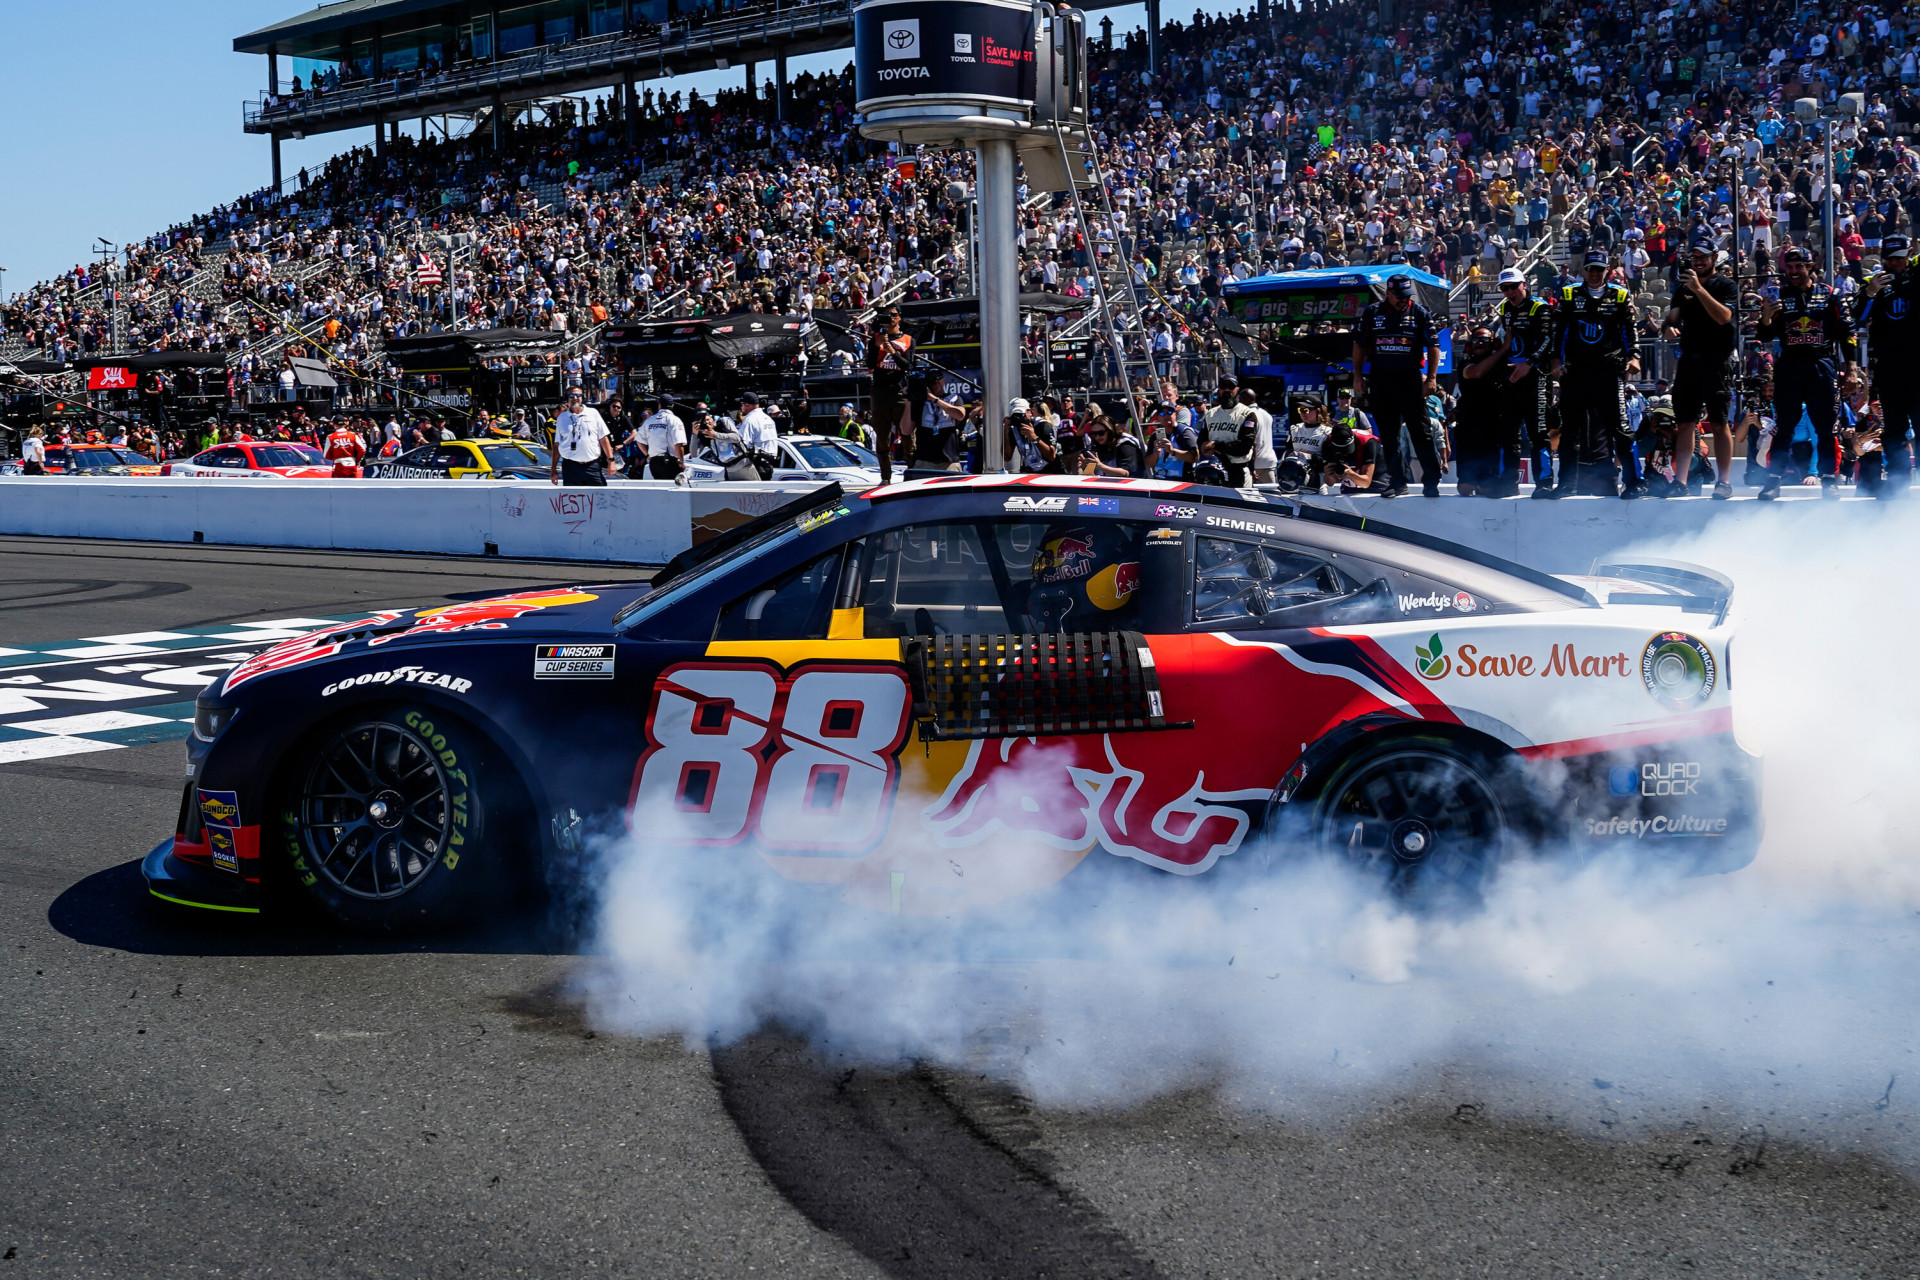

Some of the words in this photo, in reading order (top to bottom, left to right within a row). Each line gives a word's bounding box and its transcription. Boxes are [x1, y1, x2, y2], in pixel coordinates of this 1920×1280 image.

[951, 55, 976, 63] TOYOTA
[986, 46, 1008, 59] SAVE
[1009, 49, 1033, 62] MART
[986, 58, 1014, 67] COMPANIES
[877, 66, 930, 81] TOYOTA
[1787, 333, 1805, 345] Red
[1805, 333, 1824, 345] Bull
[523, 367, 554, 375] GAINBRIDGE
[1537, 375, 1548, 433] TRACKHOUSE
[380, 464, 446, 479] GAINBRIDGE
[549, 492, 594, 520] WESTY
[1003, 496, 1070, 509] SVG
[1205, 516, 1276, 535] SIEMENS
[1062, 558, 1091, 580] Bull
[1398, 594, 1451, 612] Wendy's
[561, 646, 604, 658] NASCAR
[1456, 644, 1536, 678] Save
[1541, 643, 1632, 678] Mart
[545, 660, 567, 672] CUP
[567, 660, 604, 673] SERIES
[1696, 642, 1715, 699] TRACKHOUSE
[321, 666, 473, 697] GOODYEAR
[630, 665, 911, 853] 88
[1641, 762, 1700, 780] QUAD
[405, 711, 469, 870] GOODYEAR
[1641, 779, 1700, 797] LOCK
[202, 802, 235, 815] SUNOCO
[1583, 814, 1728, 839] SafetyCulture
[212, 836, 231, 846] SUNOCO
[213, 851, 236, 864] ROOKIE
